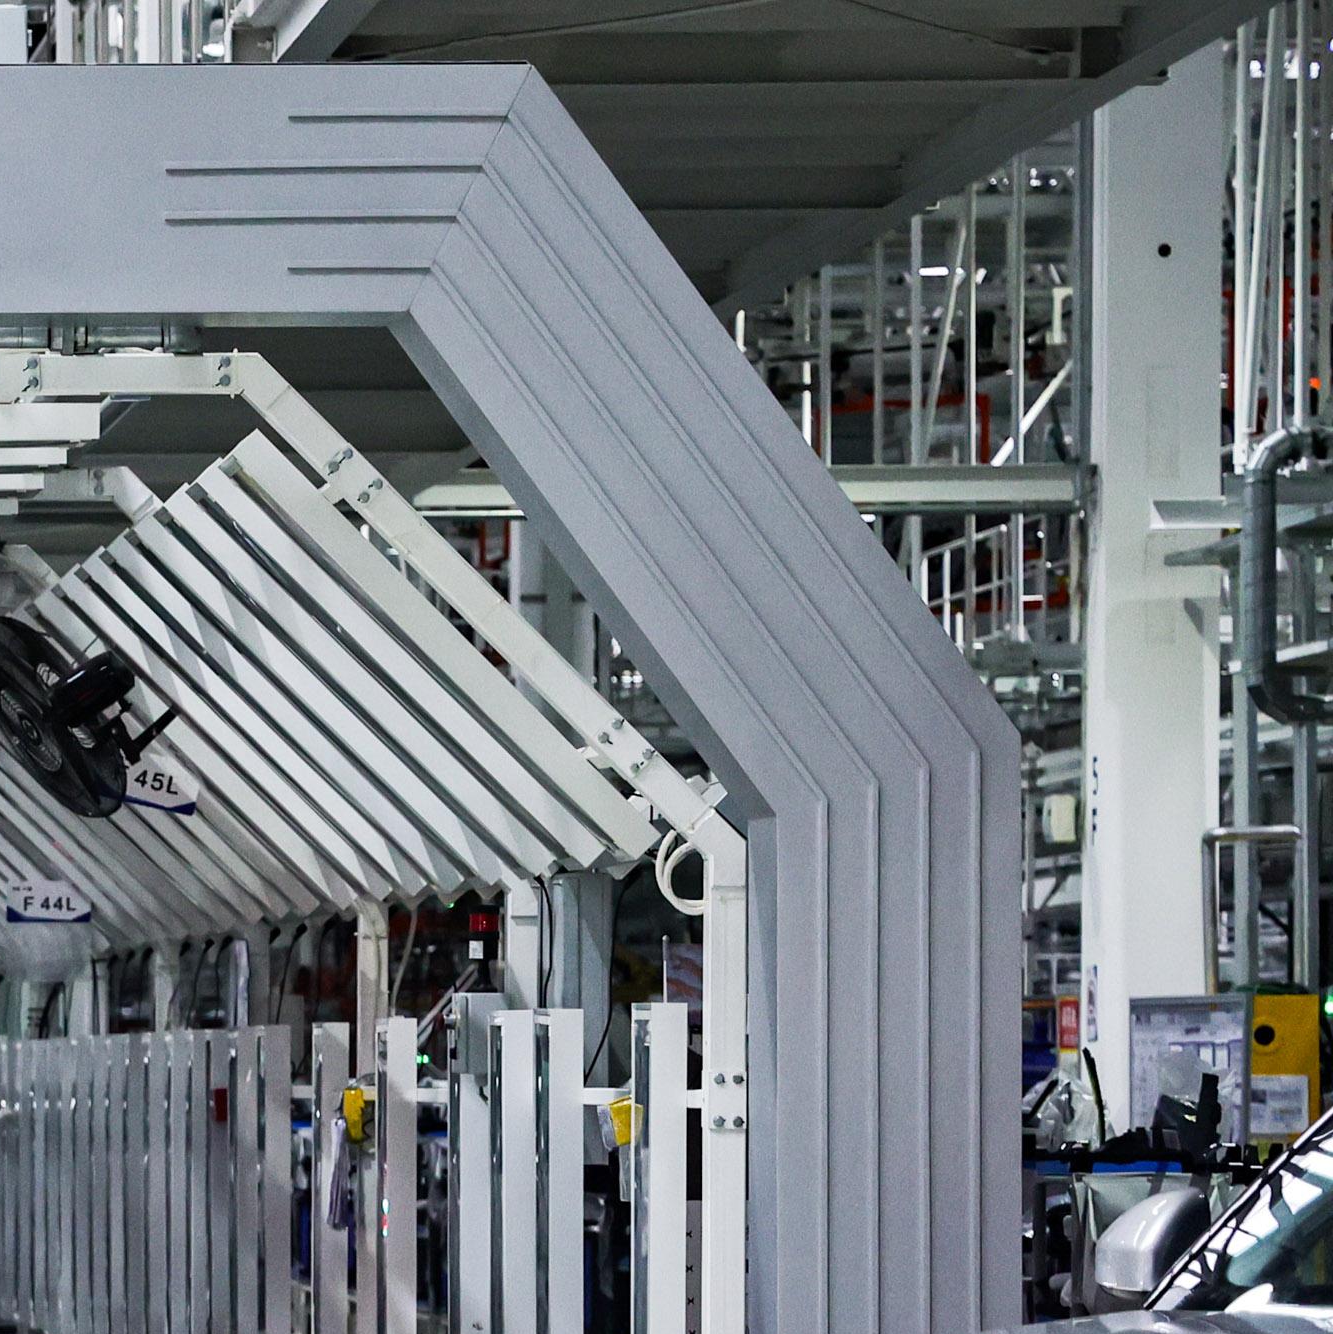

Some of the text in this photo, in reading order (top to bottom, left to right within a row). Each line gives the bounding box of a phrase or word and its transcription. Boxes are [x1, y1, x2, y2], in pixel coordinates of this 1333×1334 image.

[134, 770, 179, 795] 45L
[24, 897, 77, 911] F 44L
